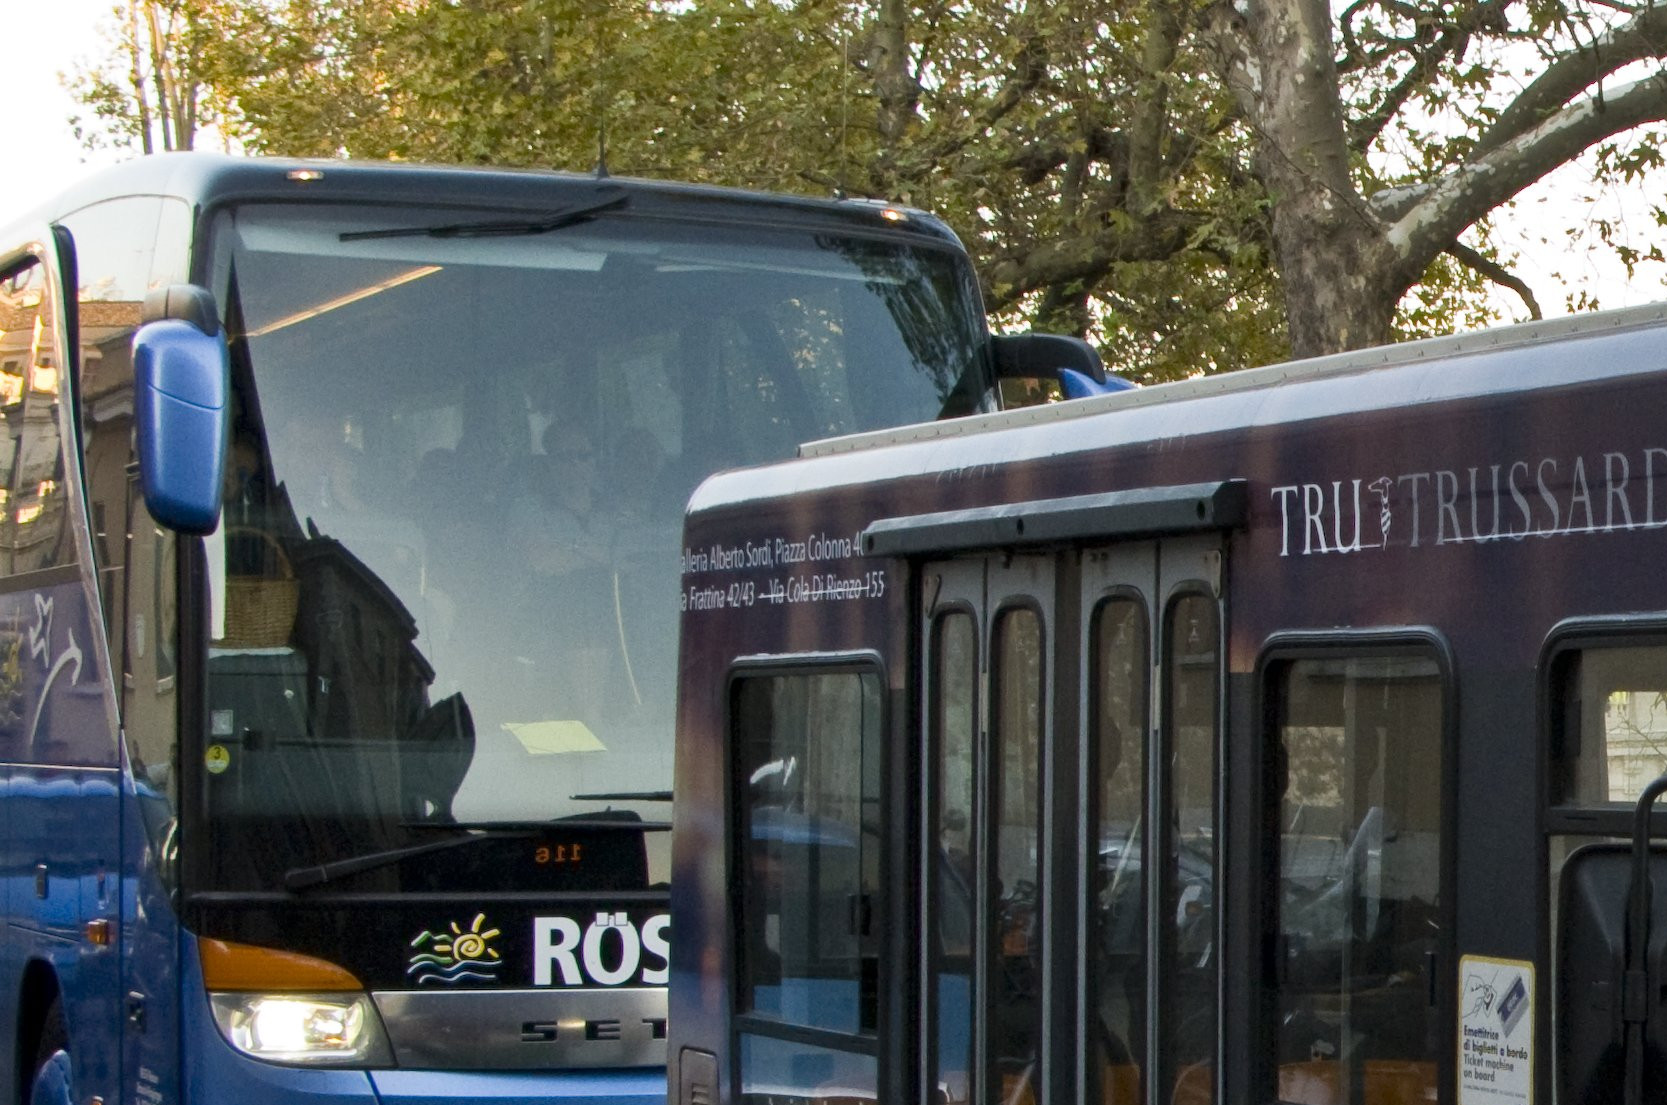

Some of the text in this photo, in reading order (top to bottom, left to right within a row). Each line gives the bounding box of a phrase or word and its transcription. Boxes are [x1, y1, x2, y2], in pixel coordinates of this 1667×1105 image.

[1271, 479, 1362, 556] TRU
[709, 544, 745, 571] Alberto
[746, 539, 774, 568] Sordi,
[775, 536, 806, 564] Piazza
[808, 531, 851, 561] Colonna
[690, 584, 725, 611] Frattina
[727, 581, 755, 609] 42/43
[769, 577, 785, 604] Via
[787, 574, 810, 603] Cola
[813, 574, 825, 602] Di
[827, 573, 862, 601] Rienzo
[865, 571, 885, 598] 155
[1464, 1054, 1514, 1072] Ticket machine
[1507, 1045, 1528, 1060] bordo
[1464, 1068, 1495, 1082] on board
